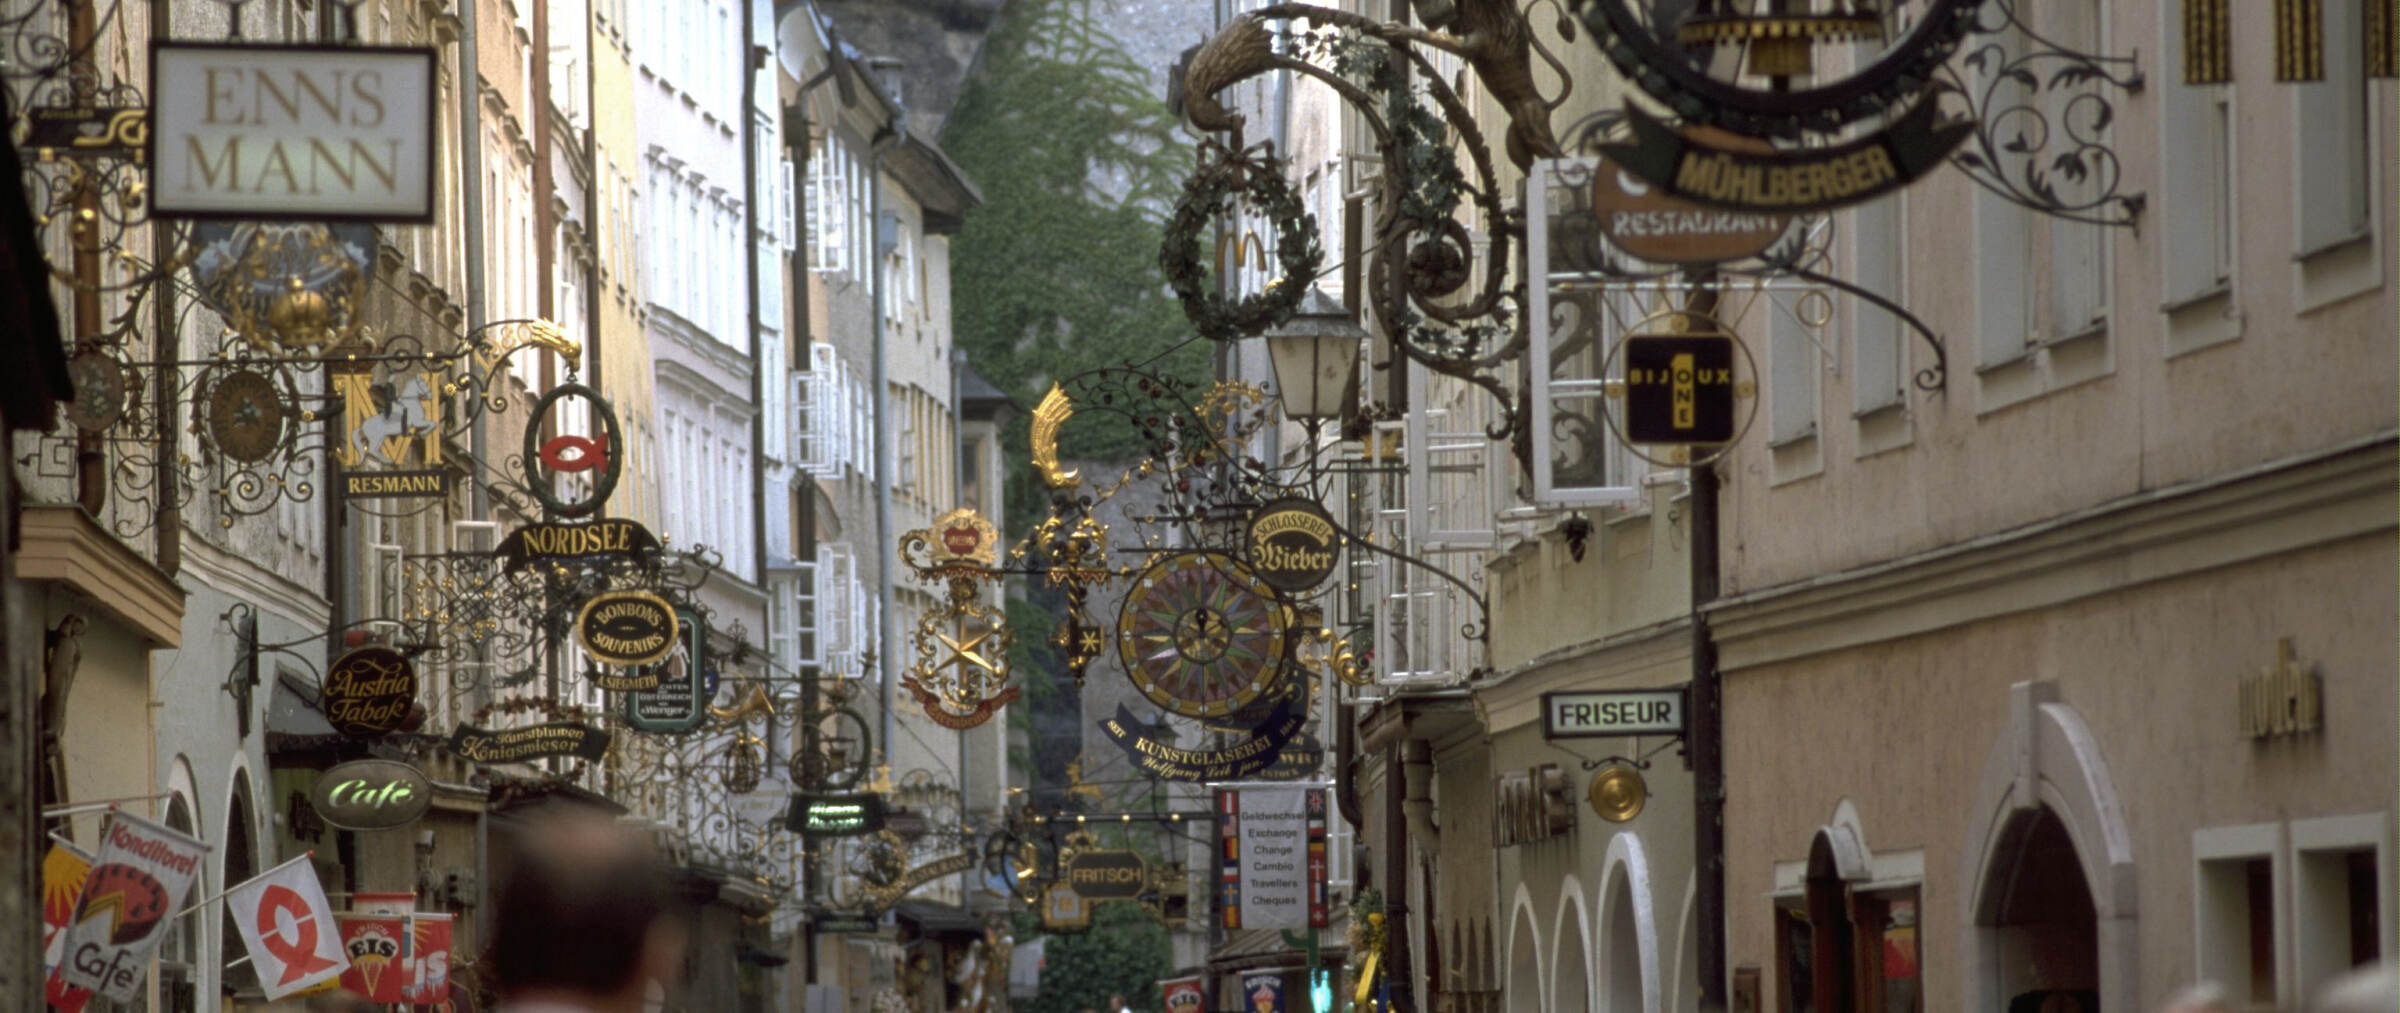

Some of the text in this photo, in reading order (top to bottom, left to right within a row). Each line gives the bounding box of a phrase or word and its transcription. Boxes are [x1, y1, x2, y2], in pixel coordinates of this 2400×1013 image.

[200, 66, 386, 128] ENNS
[181, 133, 402, 196] MANN
[1675, 145, 1896, 206] MÜHLBERGER
[348, 474, 441, 495] RESMANN
[1256, 512, 1330, 538] SCHLOSSEREI
[522, 523, 634, 555] NORDSEE
[1250, 541, 1332, 571] Wieber
[596, 602, 662, 627] BONBONS
[592, 631, 664, 654] SOUVENIRS
[326, 659, 411, 697] Austria
[329, 694, 410, 732] Tabak
[1559, 700, 1671, 727] FRISEUR
[1106, 718, 1127, 739] SEIT
[1135, 735, 1273, 765] KUNSTGLASEREI
[328, 778, 414, 809] Café
[1248, 828, 1298, 839] Exchange
[1254, 845, 1293, 856] Change
[1073, 867, 1141, 883] FRITSCH
[1253, 861, 1294, 871] Cambio
[1250, 878, 1298, 889] Travellers
[1252, 895, 1297, 906] Cheques
[350, 938, 396, 960] EIS
[74, 942, 138, 991] Café
